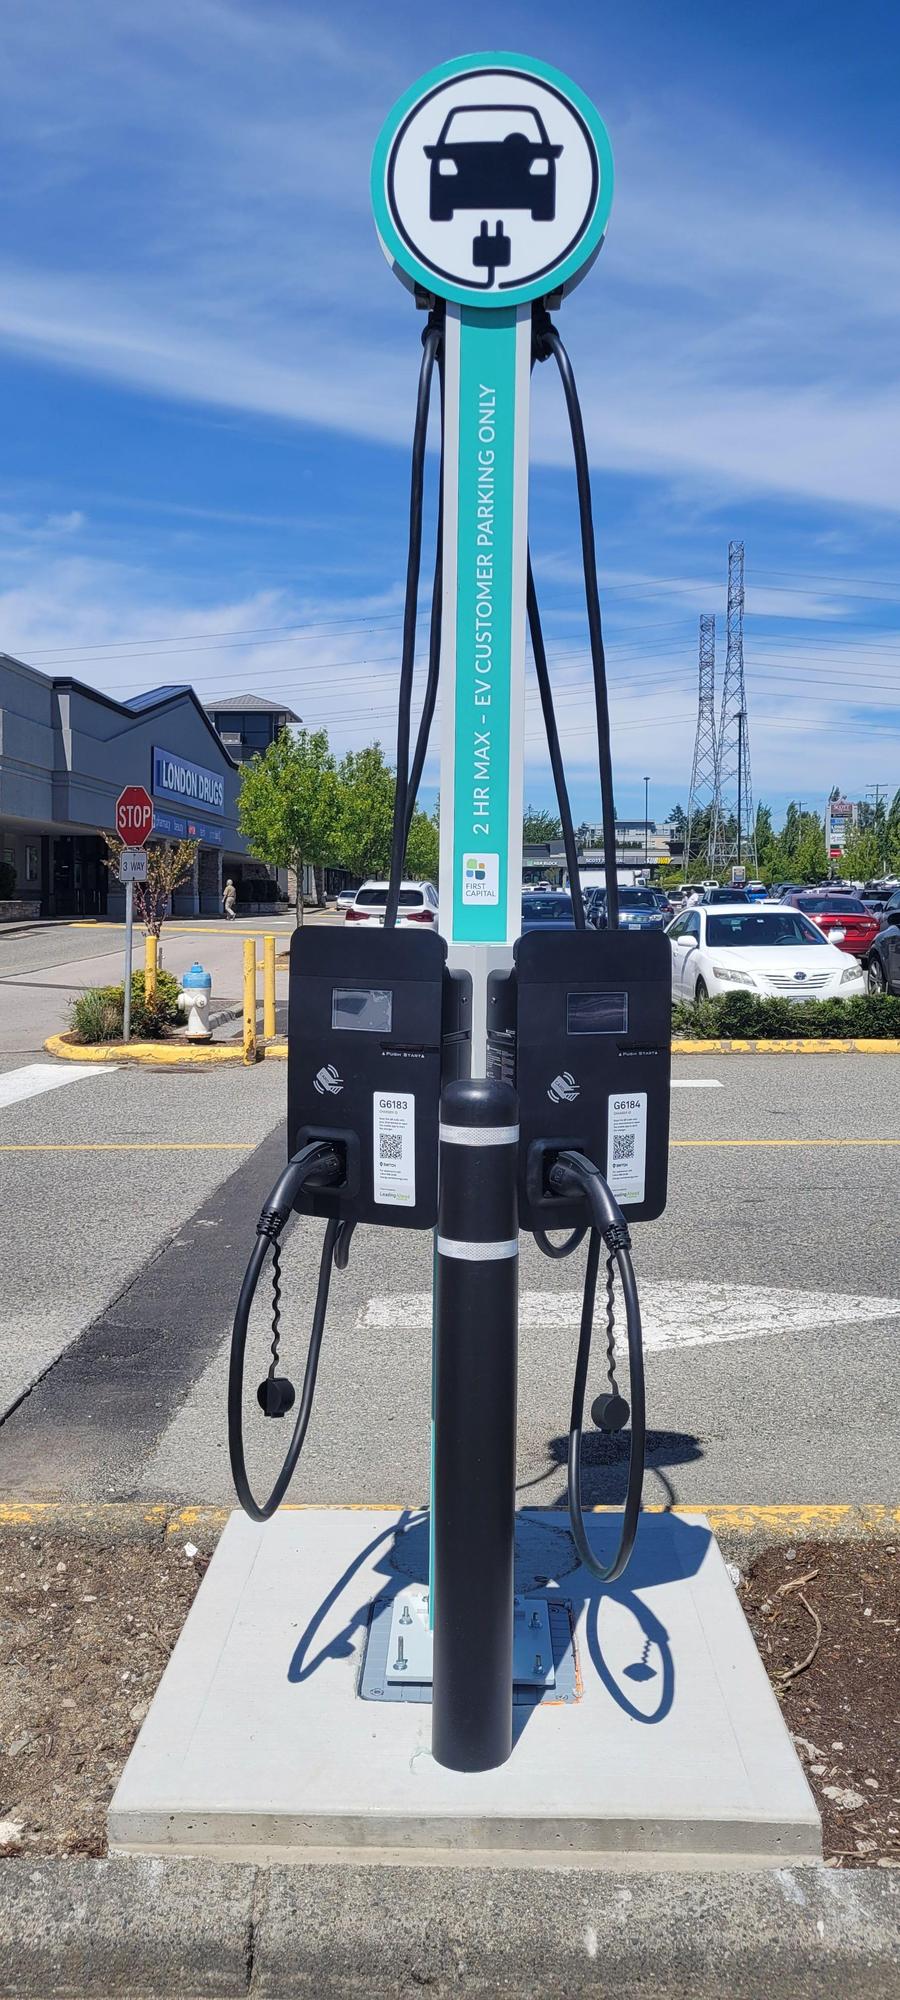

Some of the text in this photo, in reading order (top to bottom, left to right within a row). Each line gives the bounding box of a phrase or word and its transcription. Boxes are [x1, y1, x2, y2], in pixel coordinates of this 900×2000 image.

[479, 384, 496, 443] ONLY
[476, 450, 495, 546] PARKING
[475, 553, 494, 674] CUSTOMER
[474, 679, 492, 706] EV
[473, 731, 491, 780] MAX
[162, 760, 223, 806] LONDON DRUGS
[473, 787, 490, 816] HR
[119, 805, 151, 828] STOP
[472, 823, 489, 835] 2
[122, 861, 145, 872] 3 WAY
[465, 882, 496, 897] FIRST CAPITAL
[379, 1099, 408, 1110] G6183
[613, 1100, 641, 1110] G6184
